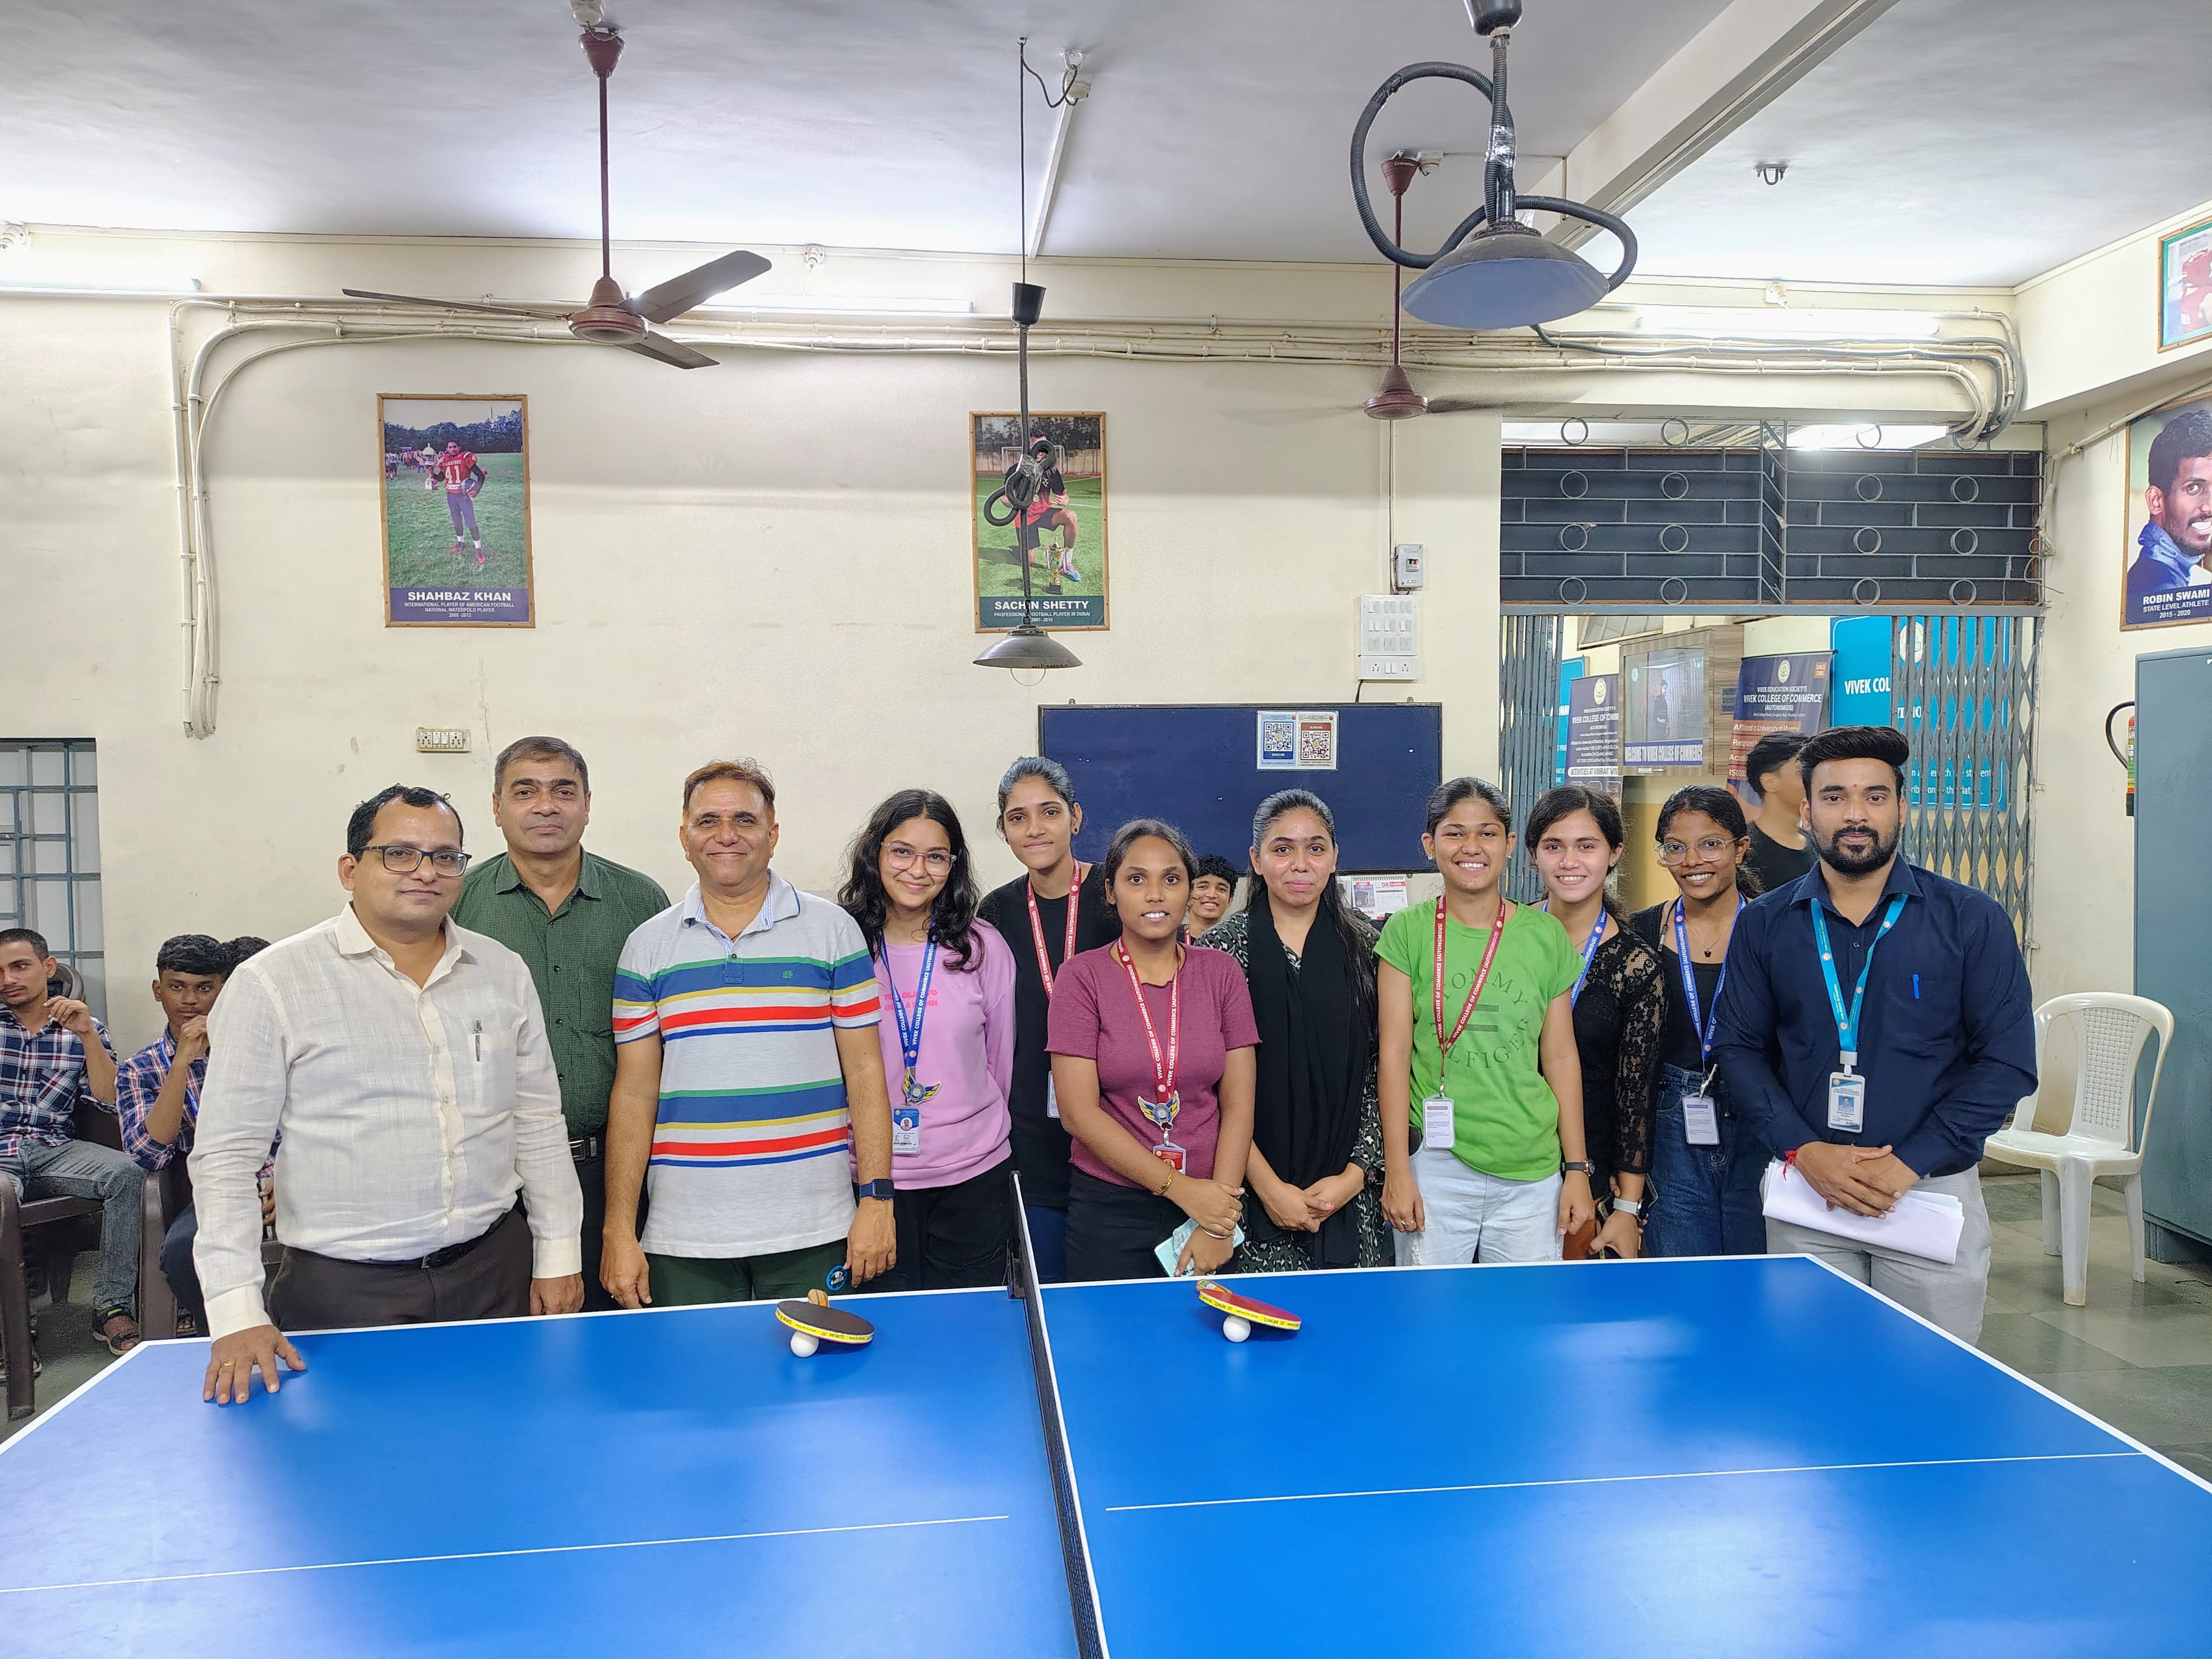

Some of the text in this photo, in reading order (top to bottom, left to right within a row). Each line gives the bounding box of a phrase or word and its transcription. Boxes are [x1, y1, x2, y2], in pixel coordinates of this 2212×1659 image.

[446, 467, 461, 483] 41
[408, 592, 511, 601] SHAHBAZ KHAN
[1043, 601, 1090, 609] SHETTY
[2142, 589, 2210, 605] ROBIN SWAMI
[2182, 599, 2209, 608] ATHLETE
[1844, 678, 1871, 695] VIVEK
[1743, 694, 1822, 703] VIVEK COLLEGE OF COMMERCE
[1032, 911, 1042, 948] (AUTONOMOUS)
[1678, 926, 1689, 965] (AUTONOMOUS)
[1039, 948, 1048, 974] COMMERCE
[920, 971, 929, 999] COMMERCE
[1127, 965, 1144, 1002] (AUTONOMOUS)
[1452, 1023, 1462, 1038] VIVEK
[1460, 1002, 1473, 1024] COLLEGE
[1474, 968, 1487, 996] COMMERCE
[1483, 931, 1499, 969] (AUTONOMOUS)
[1684, 966, 1693, 992] COMMERCE
[919, 999, 923, 1007] OF
[1139, 1003, 1151, 1030] COMMERCE
[1708, 1024, 1716, 1040] VIVEK
[1150, 1038, 1160, 1062] COLLEGE
